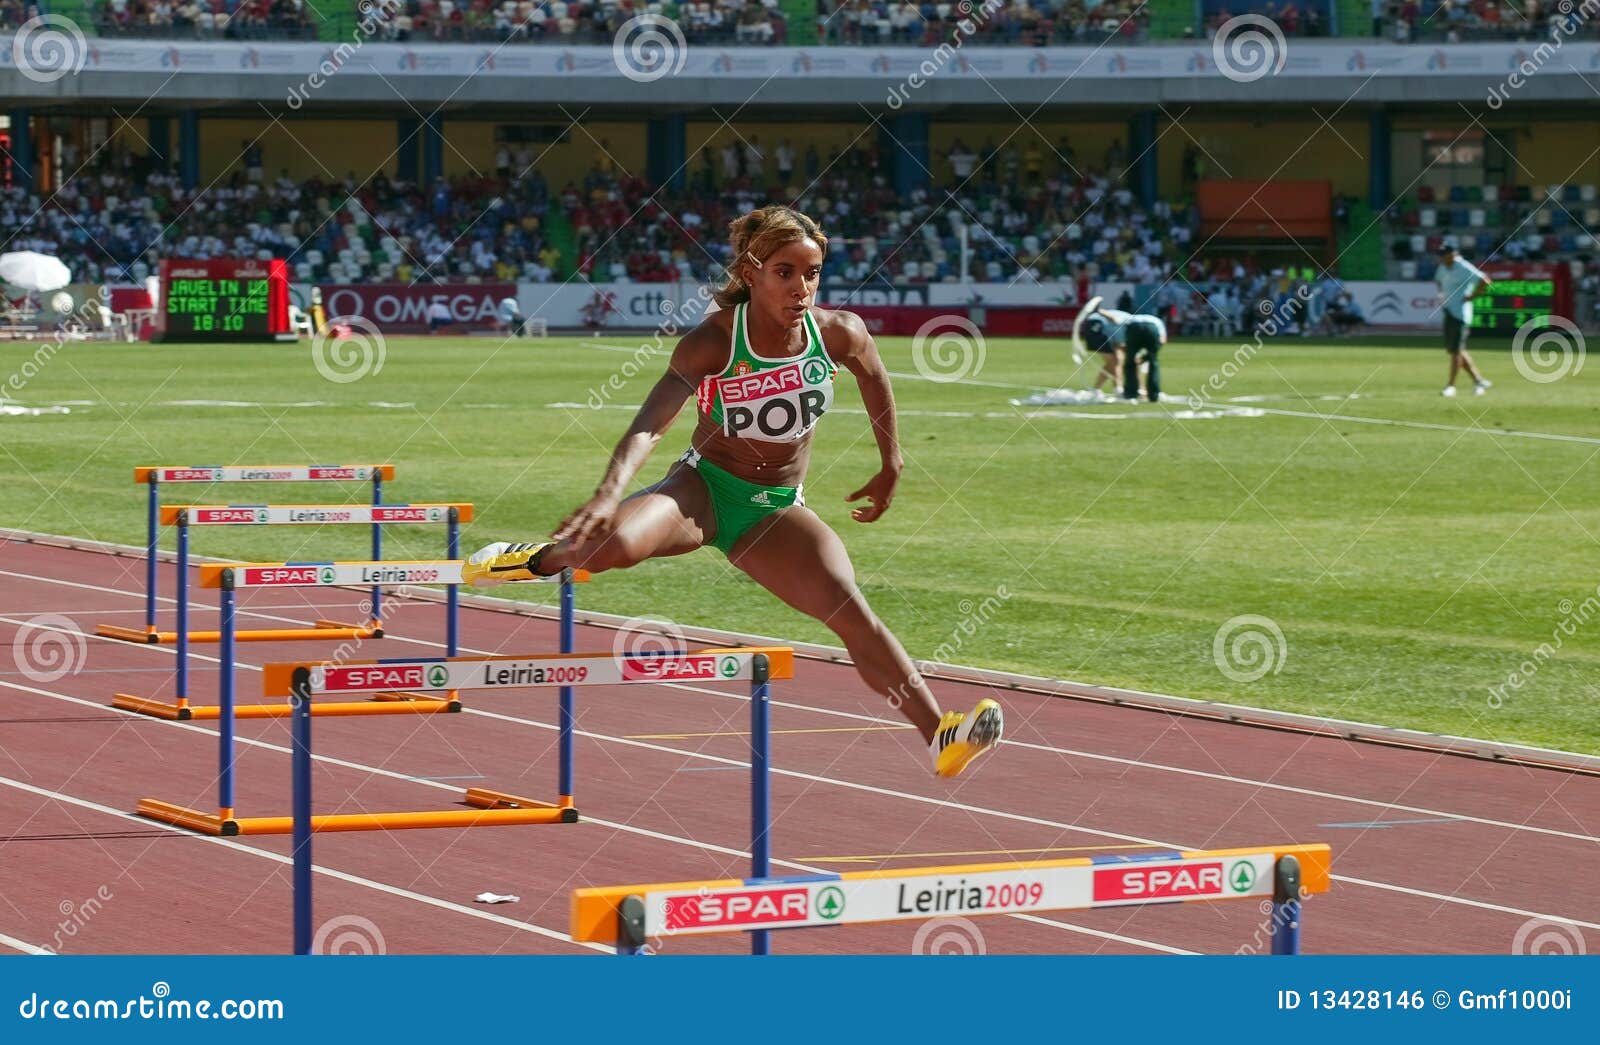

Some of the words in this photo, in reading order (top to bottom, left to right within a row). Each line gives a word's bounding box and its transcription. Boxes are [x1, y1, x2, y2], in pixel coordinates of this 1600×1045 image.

[169, 280, 239, 296] JAVELIN
[167, 297, 218, 313] START
[228, 297, 269, 313] TIME
[373, 294, 499, 323] OMGA
[629, 291, 666, 316] ctt
[722, 368, 800, 400] SPAR
[726, 389, 826, 438] POR
[174, 470, 213, 480] SPAR
[241, 469, 292, 480] Leiria2009
[318, 468, 356, 478] SPAR
[209, 511, 254, 521] SPAR
[290, 509, 351, 522] Leiria2009
[383, 510, 426, 520] SPAR
[260, 570, 317, 582] SPAR
[362, 567, 438, 583] Leiria2009
[346, 670, 423, 686] SPAR
[484, 663, 588, 685] Leiria2009
[642, 660, 716, 677] SPAR
[699, 893, 807, 922] SPAR
[897, 879, 1044, 914] Leiria2009
[1121, 867, 1222, 895] SPAR
